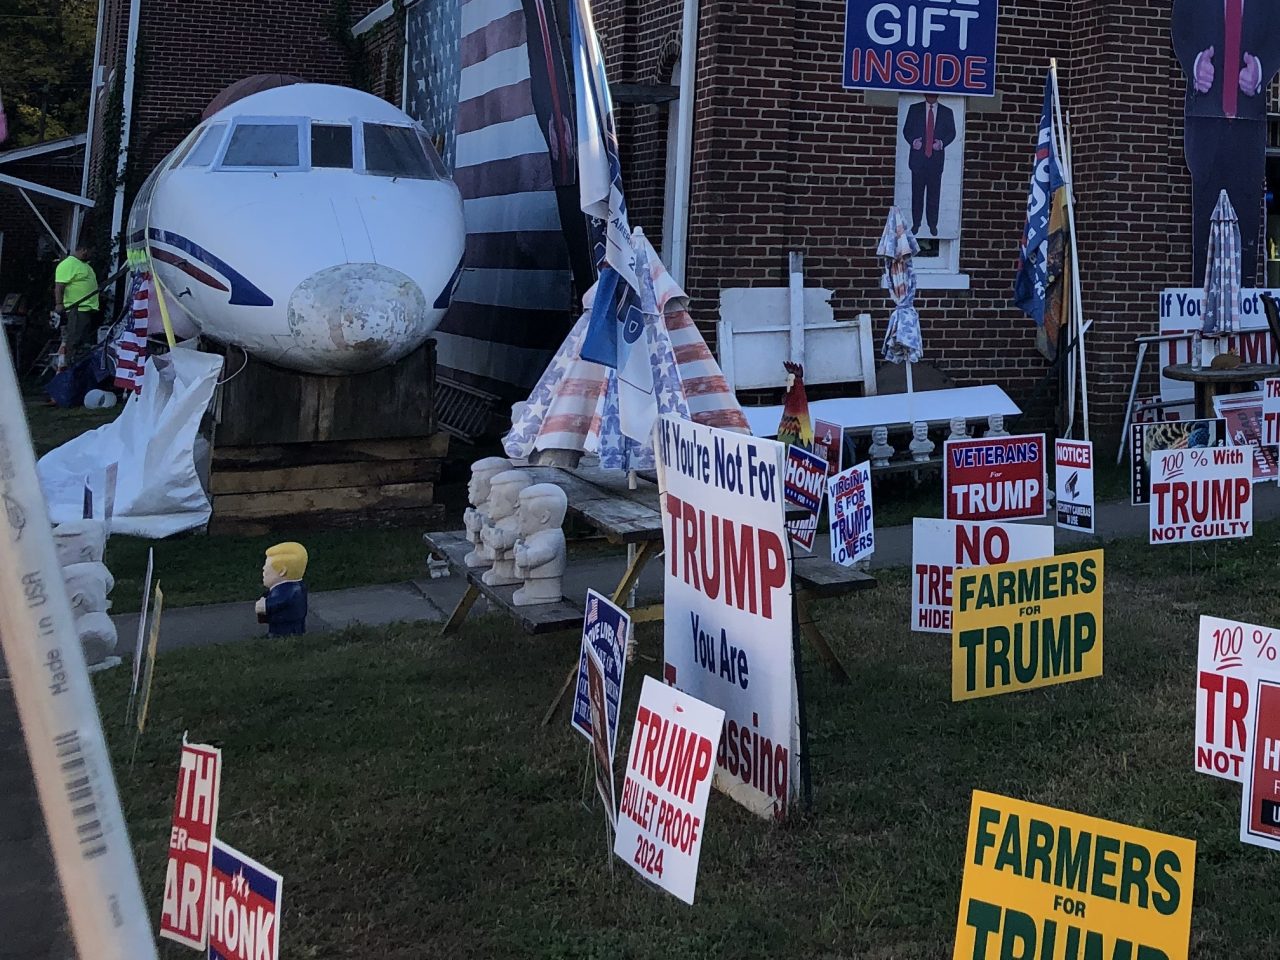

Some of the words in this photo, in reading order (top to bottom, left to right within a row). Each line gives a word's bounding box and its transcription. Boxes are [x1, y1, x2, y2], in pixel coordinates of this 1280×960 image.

[866, 3, 979, 50] GIFT
[851, 48, 987, 88] INSIDE
[1161, 294, 1172, 317] If
[1176, 293, 1201, 316] You
[662, 418, 671, 467] If
[672, 422, 710, 484] You're
[714, 436, 743, 495] Not
[748, 444, 775, 502] For
[952, 442, 1039, 469] VETERANS
[1057, 446, 1089, 463] NOTICE
[1160, 452, 1184, 476] 100
[1191, 450, 1208, 467] %
[1213, 449, 1243, 465] With
[786, 459, 825, 499] HONK
[830, 470, 869, 498] VIRGINIA
[951, 478, 1040, 515] TRUMP
[835, 501, 843, 516] IS
[846, 489, 865, 510] FOR
[1152, 477, 1250, 525] TRUMP
[787, 514, 816, 543] UMP
[832, 505, 871, 548] TRUMP
[955, 524, 1010, 566] NO
[1152, 527, 1186, 541] NOT
[1191, 521, 1249, 539] GUILTY
[667, 493, 786, 619] TRUMP
[833, 532, 873, 563] LOVERS
[22, 570, 48, 609] USA
[959, 558, 1097, 612] FARMERS
[38, 616, 55, 637] in
[918, 609, 954, 630] HIDE
[1019, 605, 1041, 617] FOR
[690, 610, 716, 674] You
[720, 627, 749, 690] Are
[959, 611, 1097, 694] TRUMP
[1212, 626, 1243, 662] 100
[1252, 630, 1277, 661] %
[44, 648, 69, 698] Made
[632, 705, 713, 805] TRUMP
[1197, 746, 1244, 778] NOT
[620, 776, 659, 833] BULLET
[655, 799, 701, 856] PROOF
[634, 834, 664, 879] 2024
[973, 805, 1182, 916] FARMERS
[210, 876, 275, 960] HONK
[1053, 894, 1086, 918] FOR
